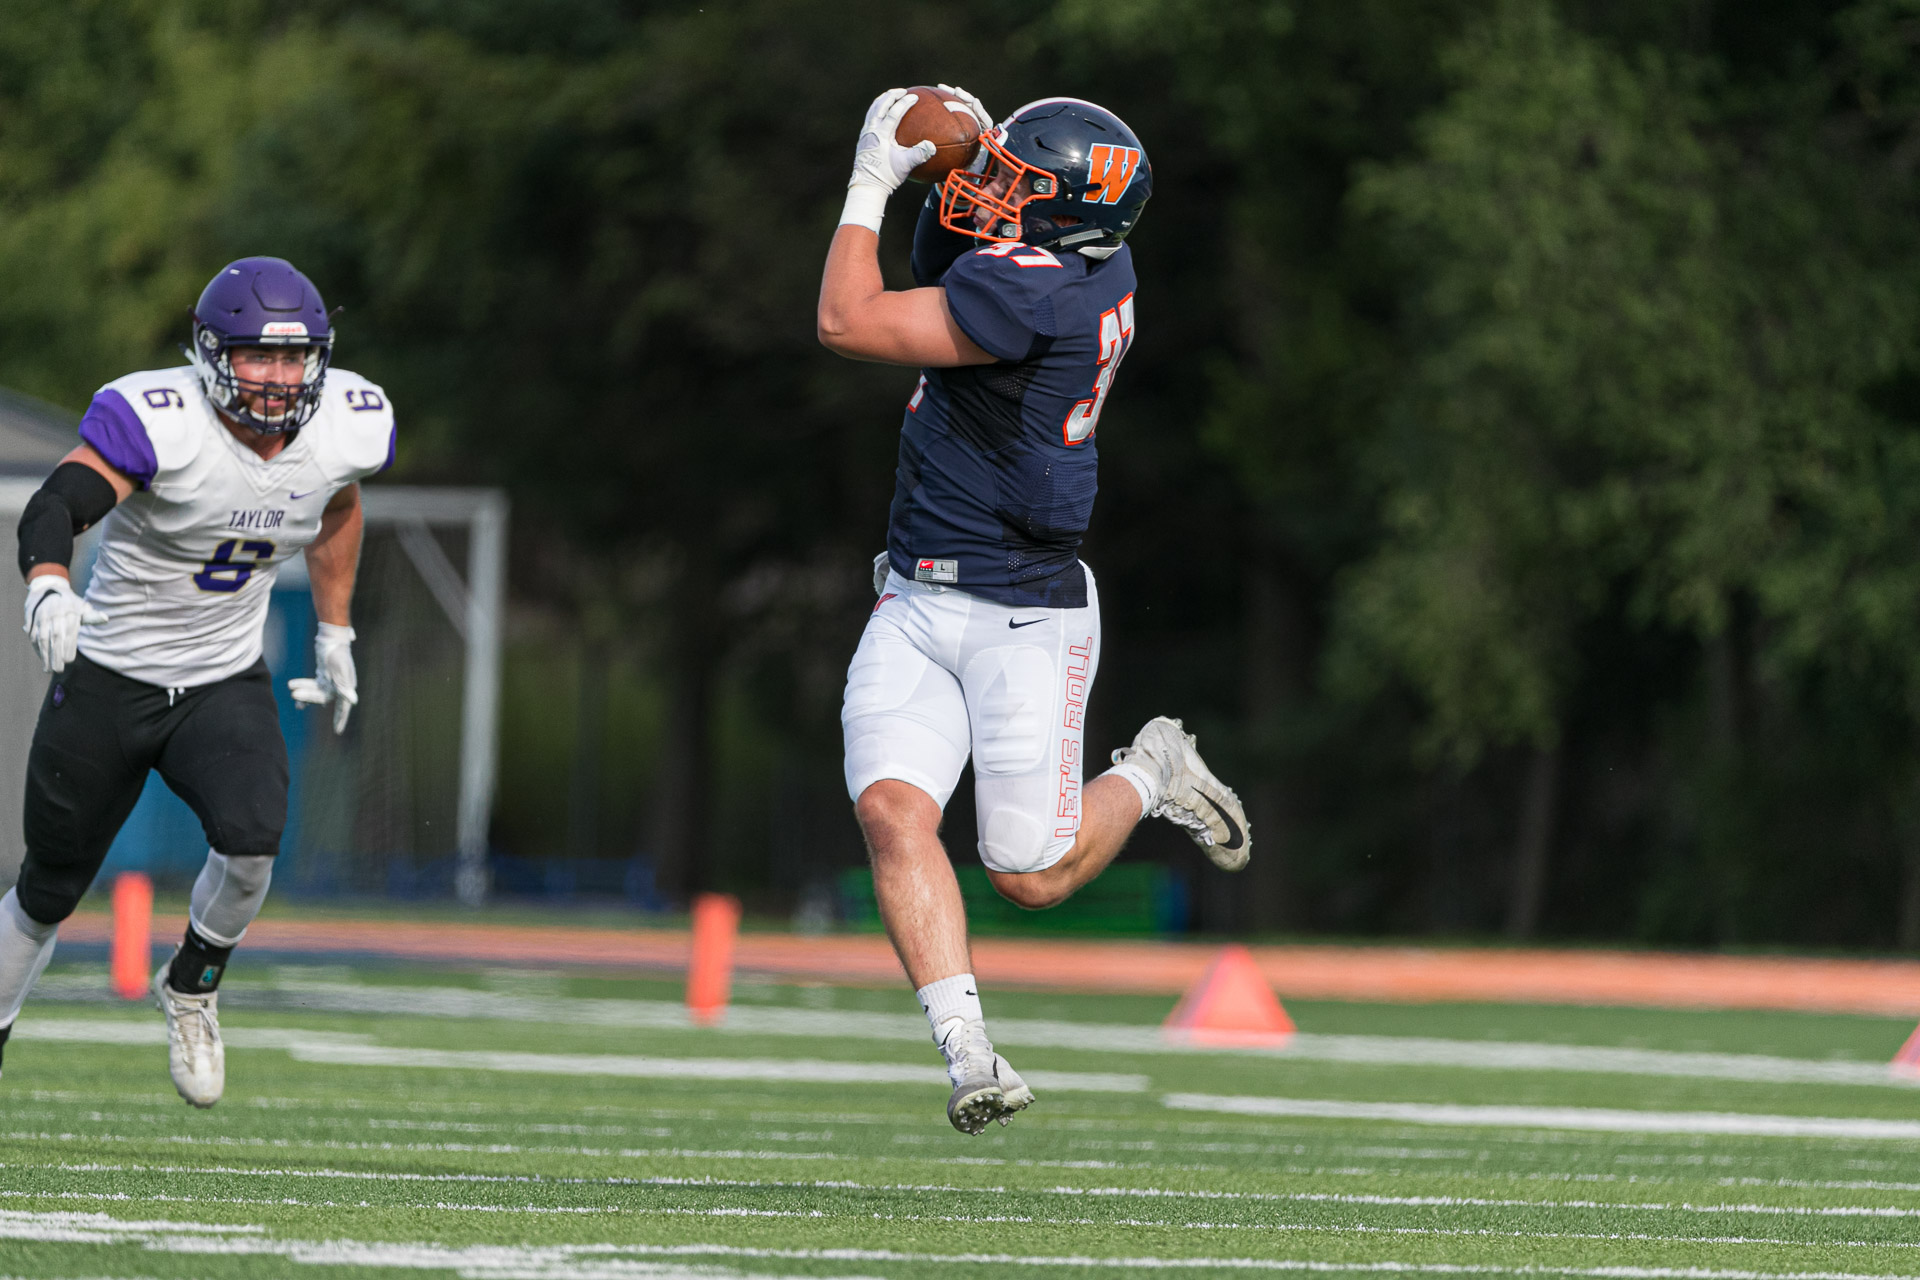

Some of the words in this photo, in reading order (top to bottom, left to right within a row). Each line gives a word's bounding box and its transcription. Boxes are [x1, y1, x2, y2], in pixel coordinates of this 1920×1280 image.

[1082, 143, 1141, 205] W
[976, 241, 1064, 268] 37
[1062, 291, 1135, 446] 37
[142, 388, 185, 410] 6
[345, 389, 384, 412] 6
[228, 509, 285, 529] TAYLOR
[190, 537, 277, 596] 6
[1063, 636, 1093, 731] ROLL
[1054, 738, 1080, 838] LET'S
